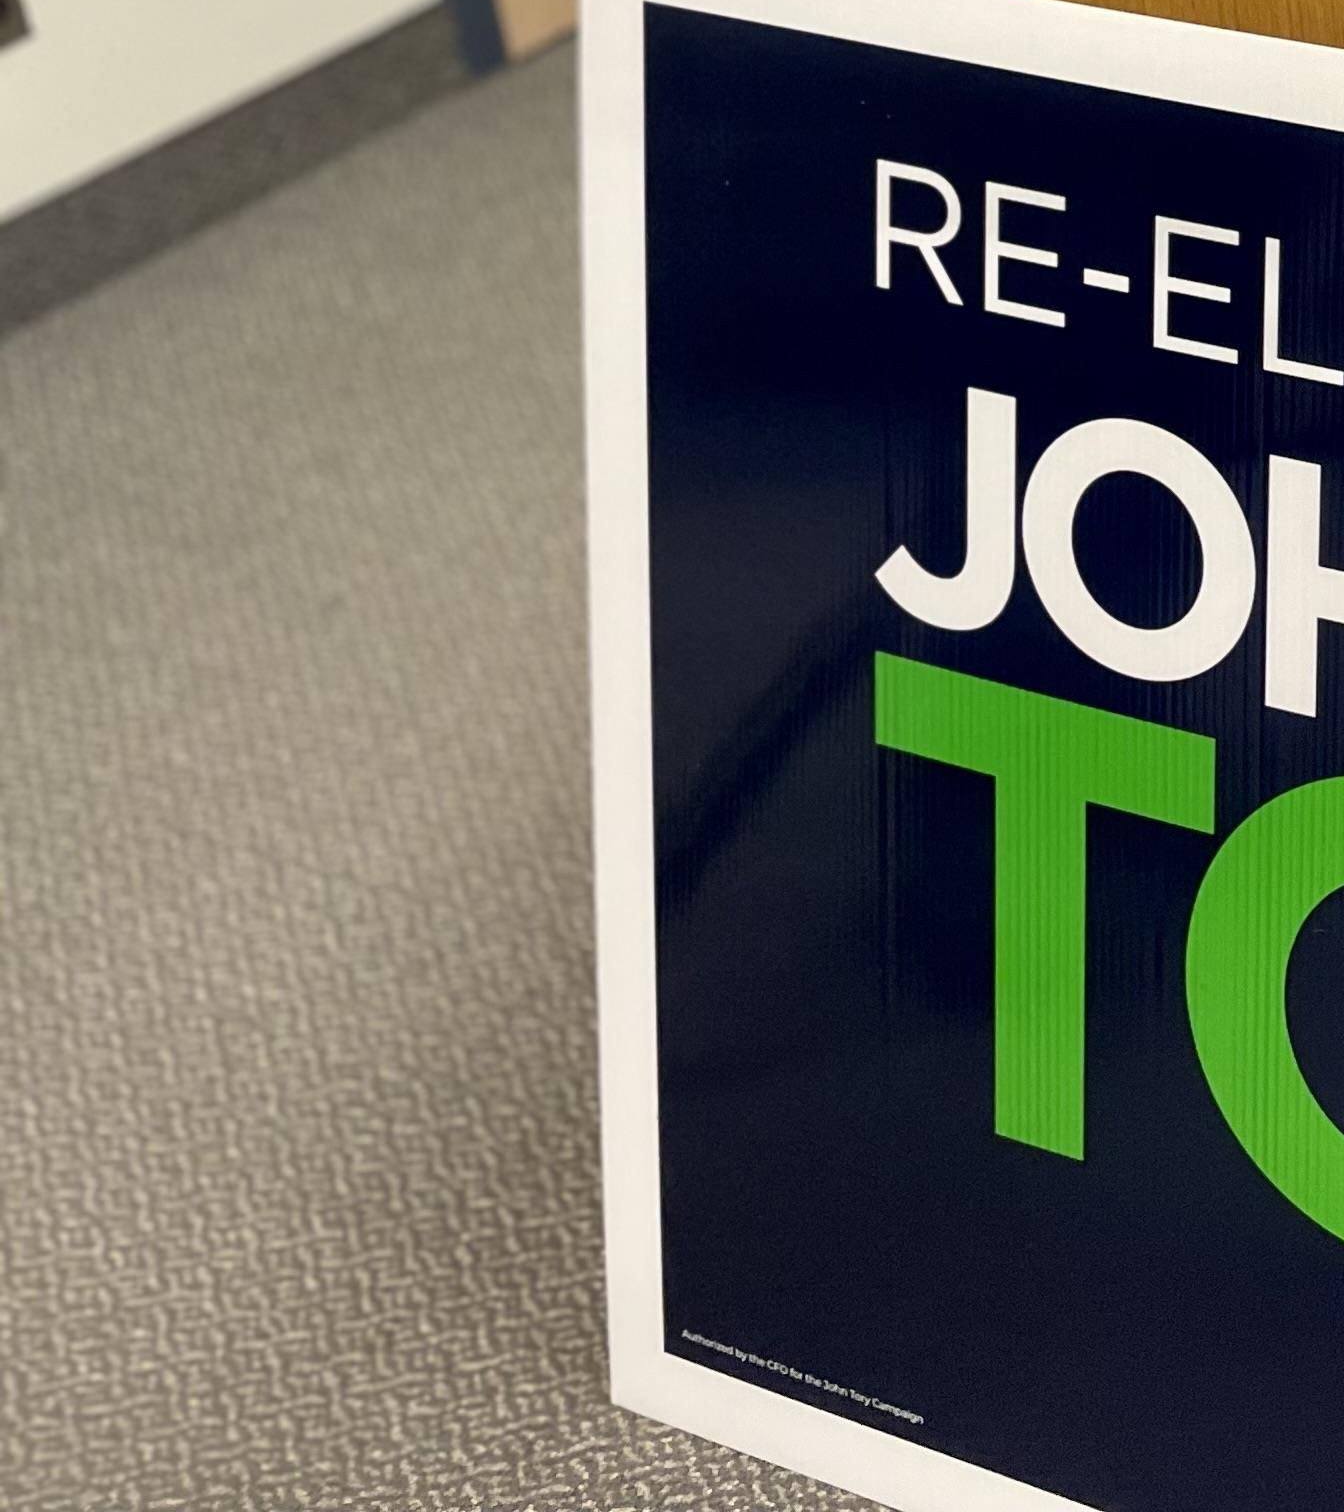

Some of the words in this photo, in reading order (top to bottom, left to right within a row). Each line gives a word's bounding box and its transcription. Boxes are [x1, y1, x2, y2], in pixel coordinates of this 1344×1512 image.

[735, 1349, 748, 1363] by
[748, 1354, 765, 1368] the
[766, 1359, 789, 1376] CFO
[789, 1368, 803, 1381] for
[804, 1374, 822, 1388] the
[823, 1379, 849, 1397] John
[850, 1389, 871, 1407] Tory
[872, 1397, 925, 1426] Campaign
